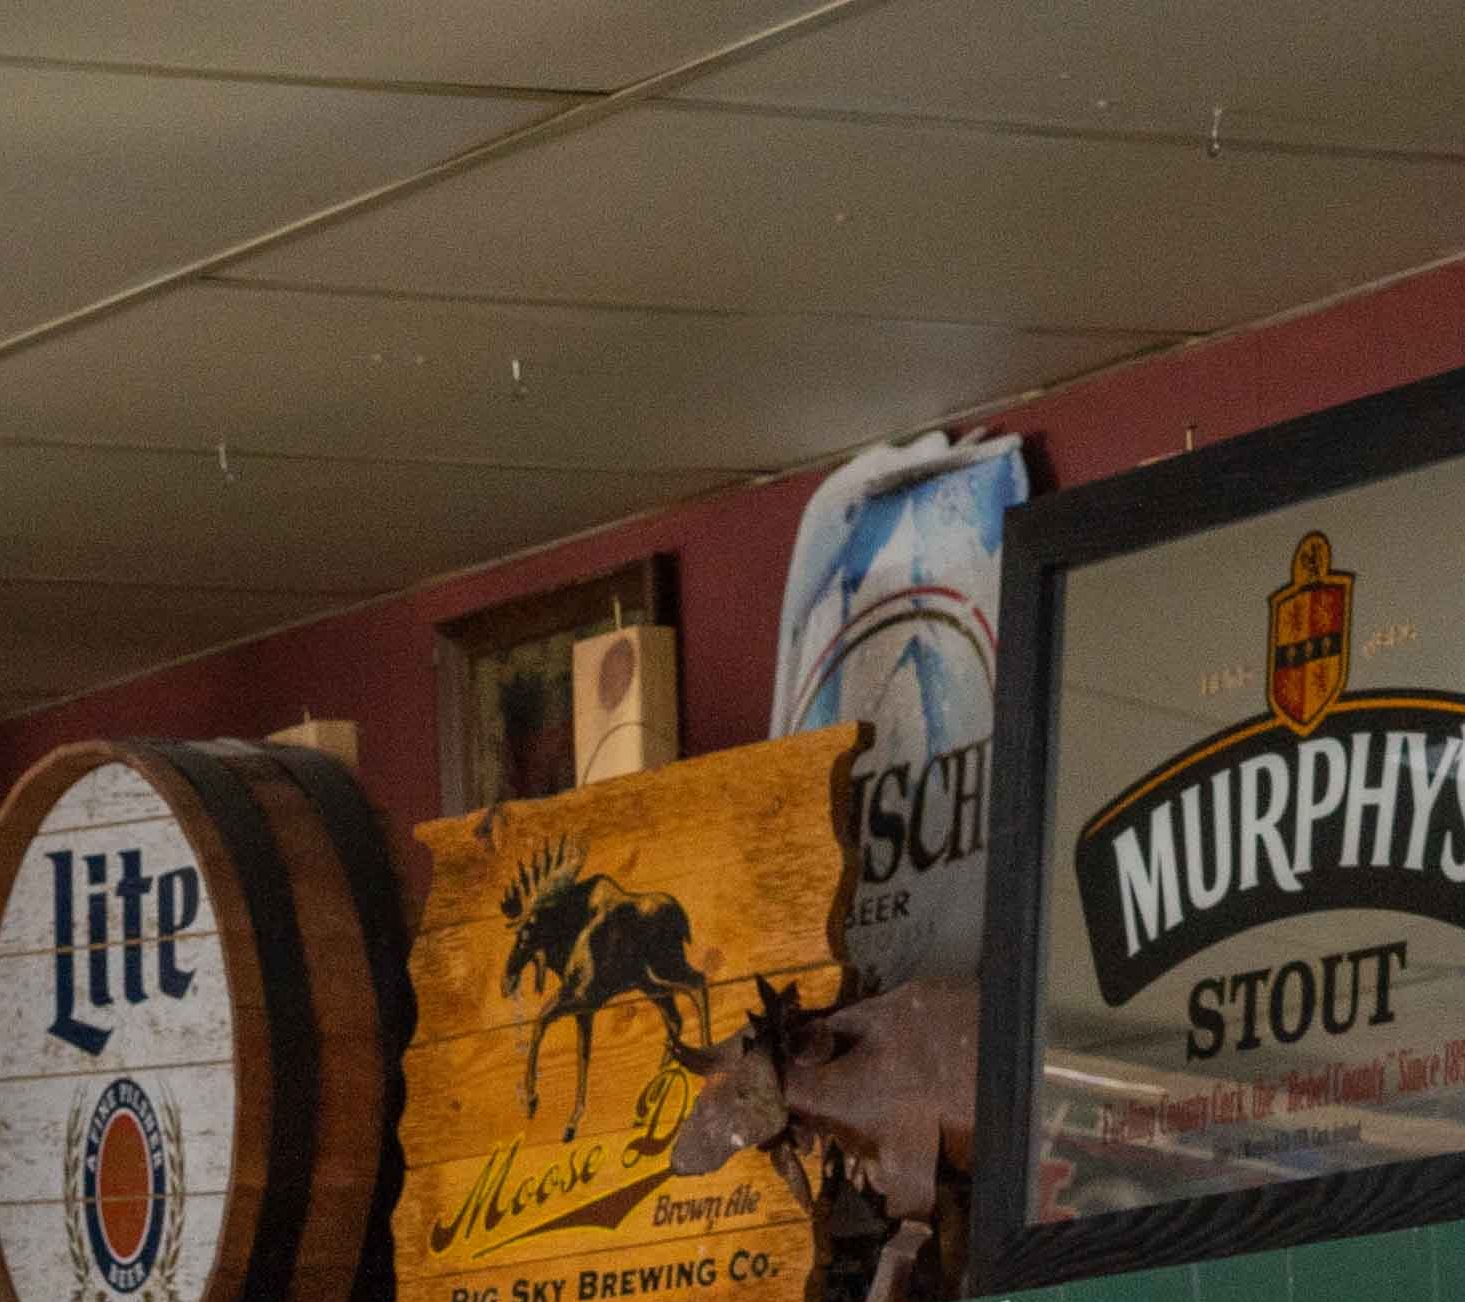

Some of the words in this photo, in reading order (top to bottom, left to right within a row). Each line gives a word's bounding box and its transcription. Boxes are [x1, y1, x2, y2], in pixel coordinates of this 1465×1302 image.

[44, 848, 198, 1056] Lite
[1186, 940, 1408, 1062] STOUT
[430, 1128, 598, 1254] Moose
[653, 1190, 721, 1232] Brown
[726, 1187, 762, 1218] Ale
[107, 1257, 151, 1292] BEER
[578, 1259, 717, 1300] BREWING
[728, 1248, 779, 1282] CO.
